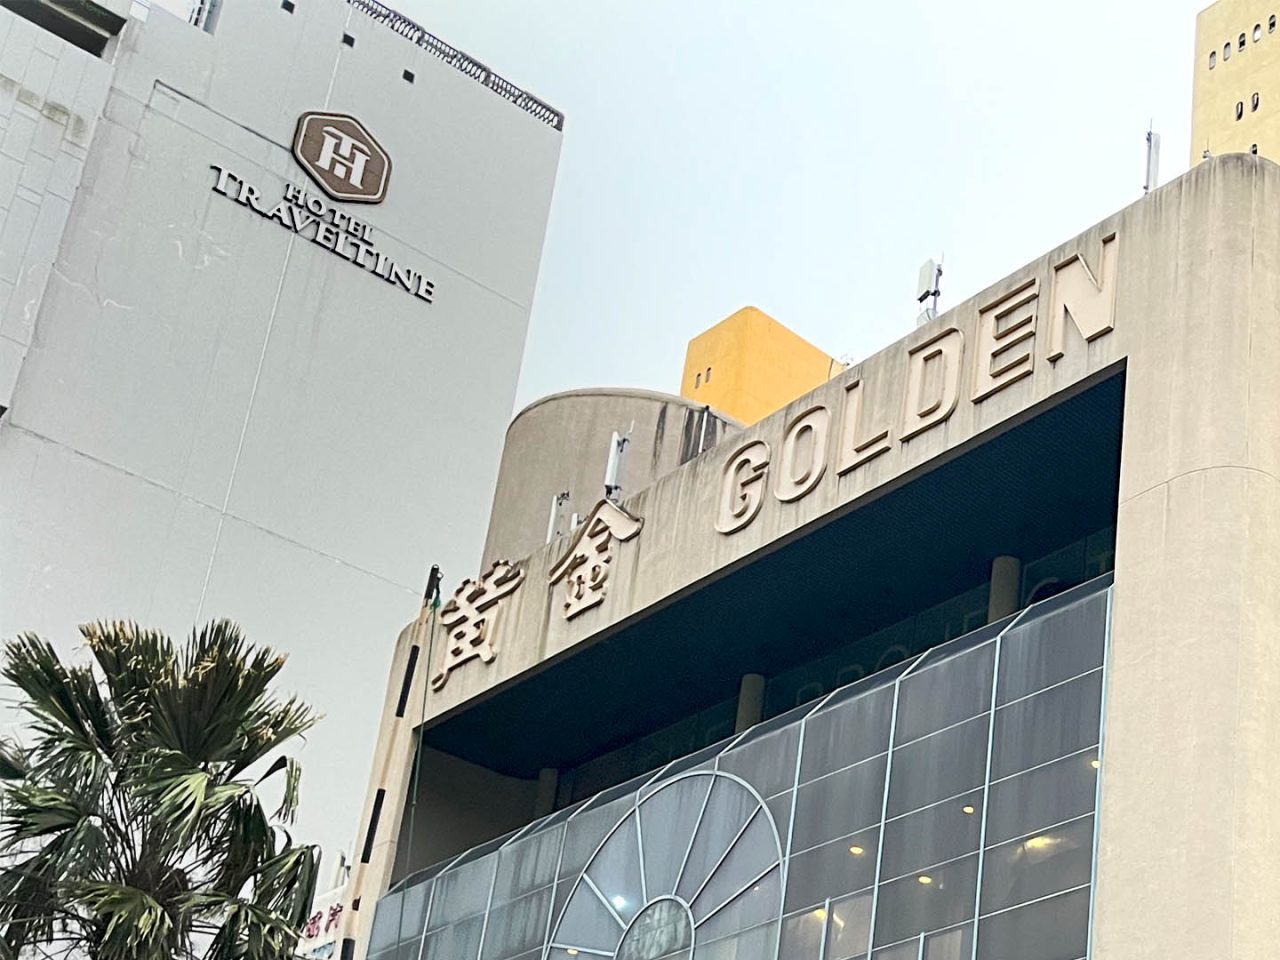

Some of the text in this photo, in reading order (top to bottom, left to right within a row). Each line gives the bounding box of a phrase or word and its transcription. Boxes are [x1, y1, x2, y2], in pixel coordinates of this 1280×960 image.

[210, 163, 436, 304] TRAVELTINE
[286, 184, 374, 246] HOTEL
[714, 231, 1118, 535] GOLDEN
